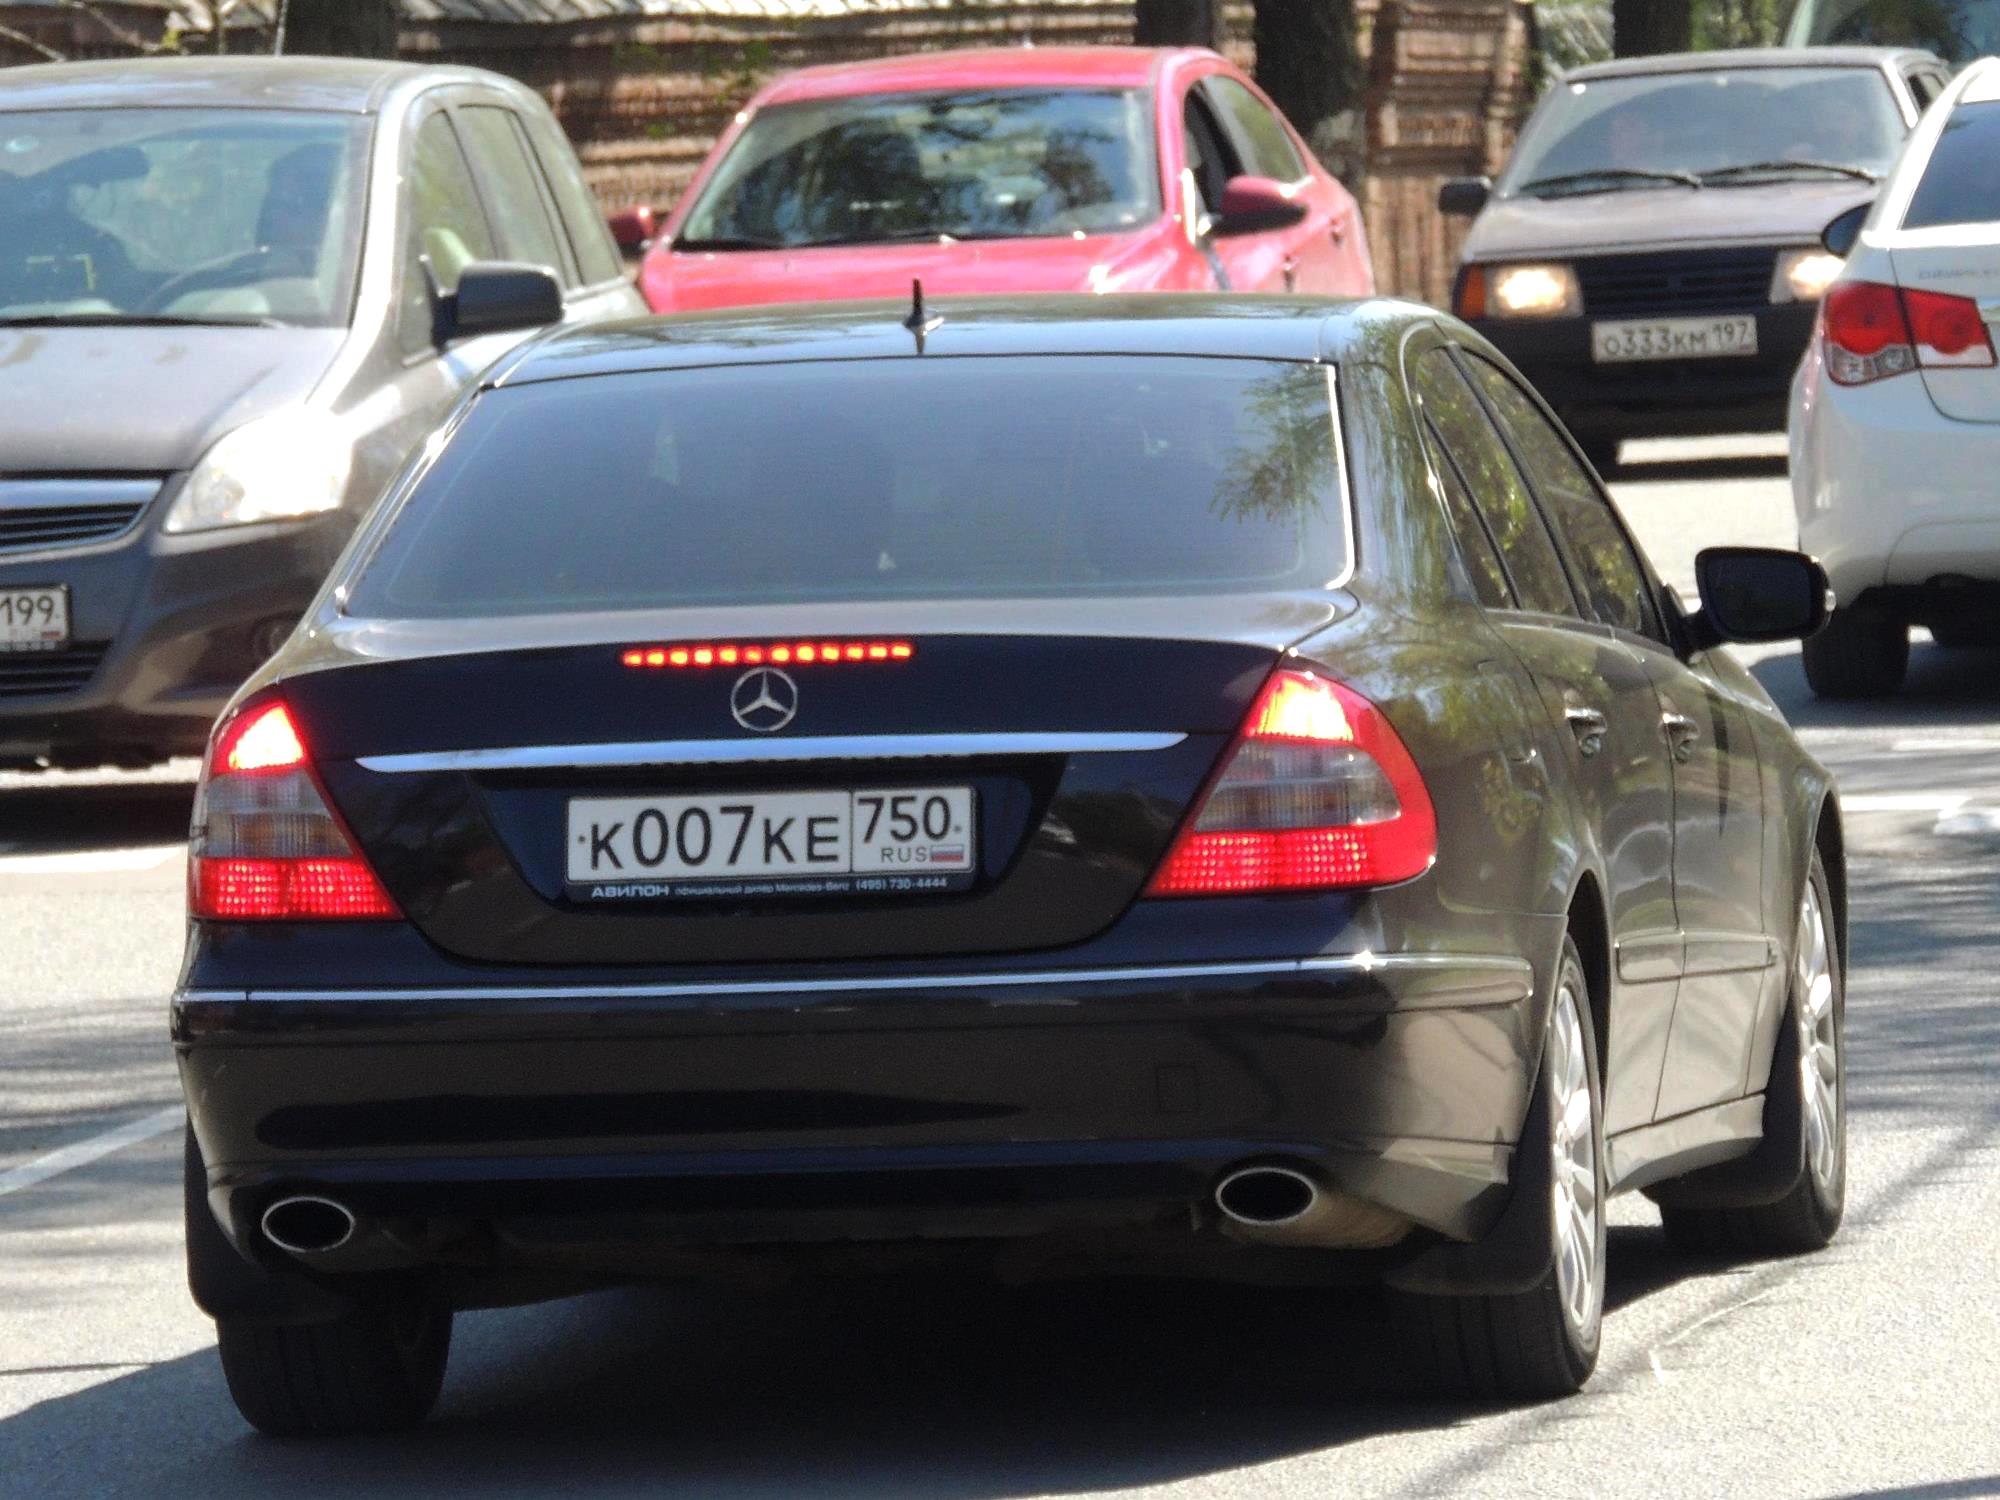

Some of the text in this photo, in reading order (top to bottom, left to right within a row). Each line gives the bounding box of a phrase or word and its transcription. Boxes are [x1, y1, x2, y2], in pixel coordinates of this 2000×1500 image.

[1712, 319, 1748, 350] 197
[0, 595, 54, 626] 199
[590, 795, 951, 870] K007KE 750
[880, 846, 928, 863] RUS
